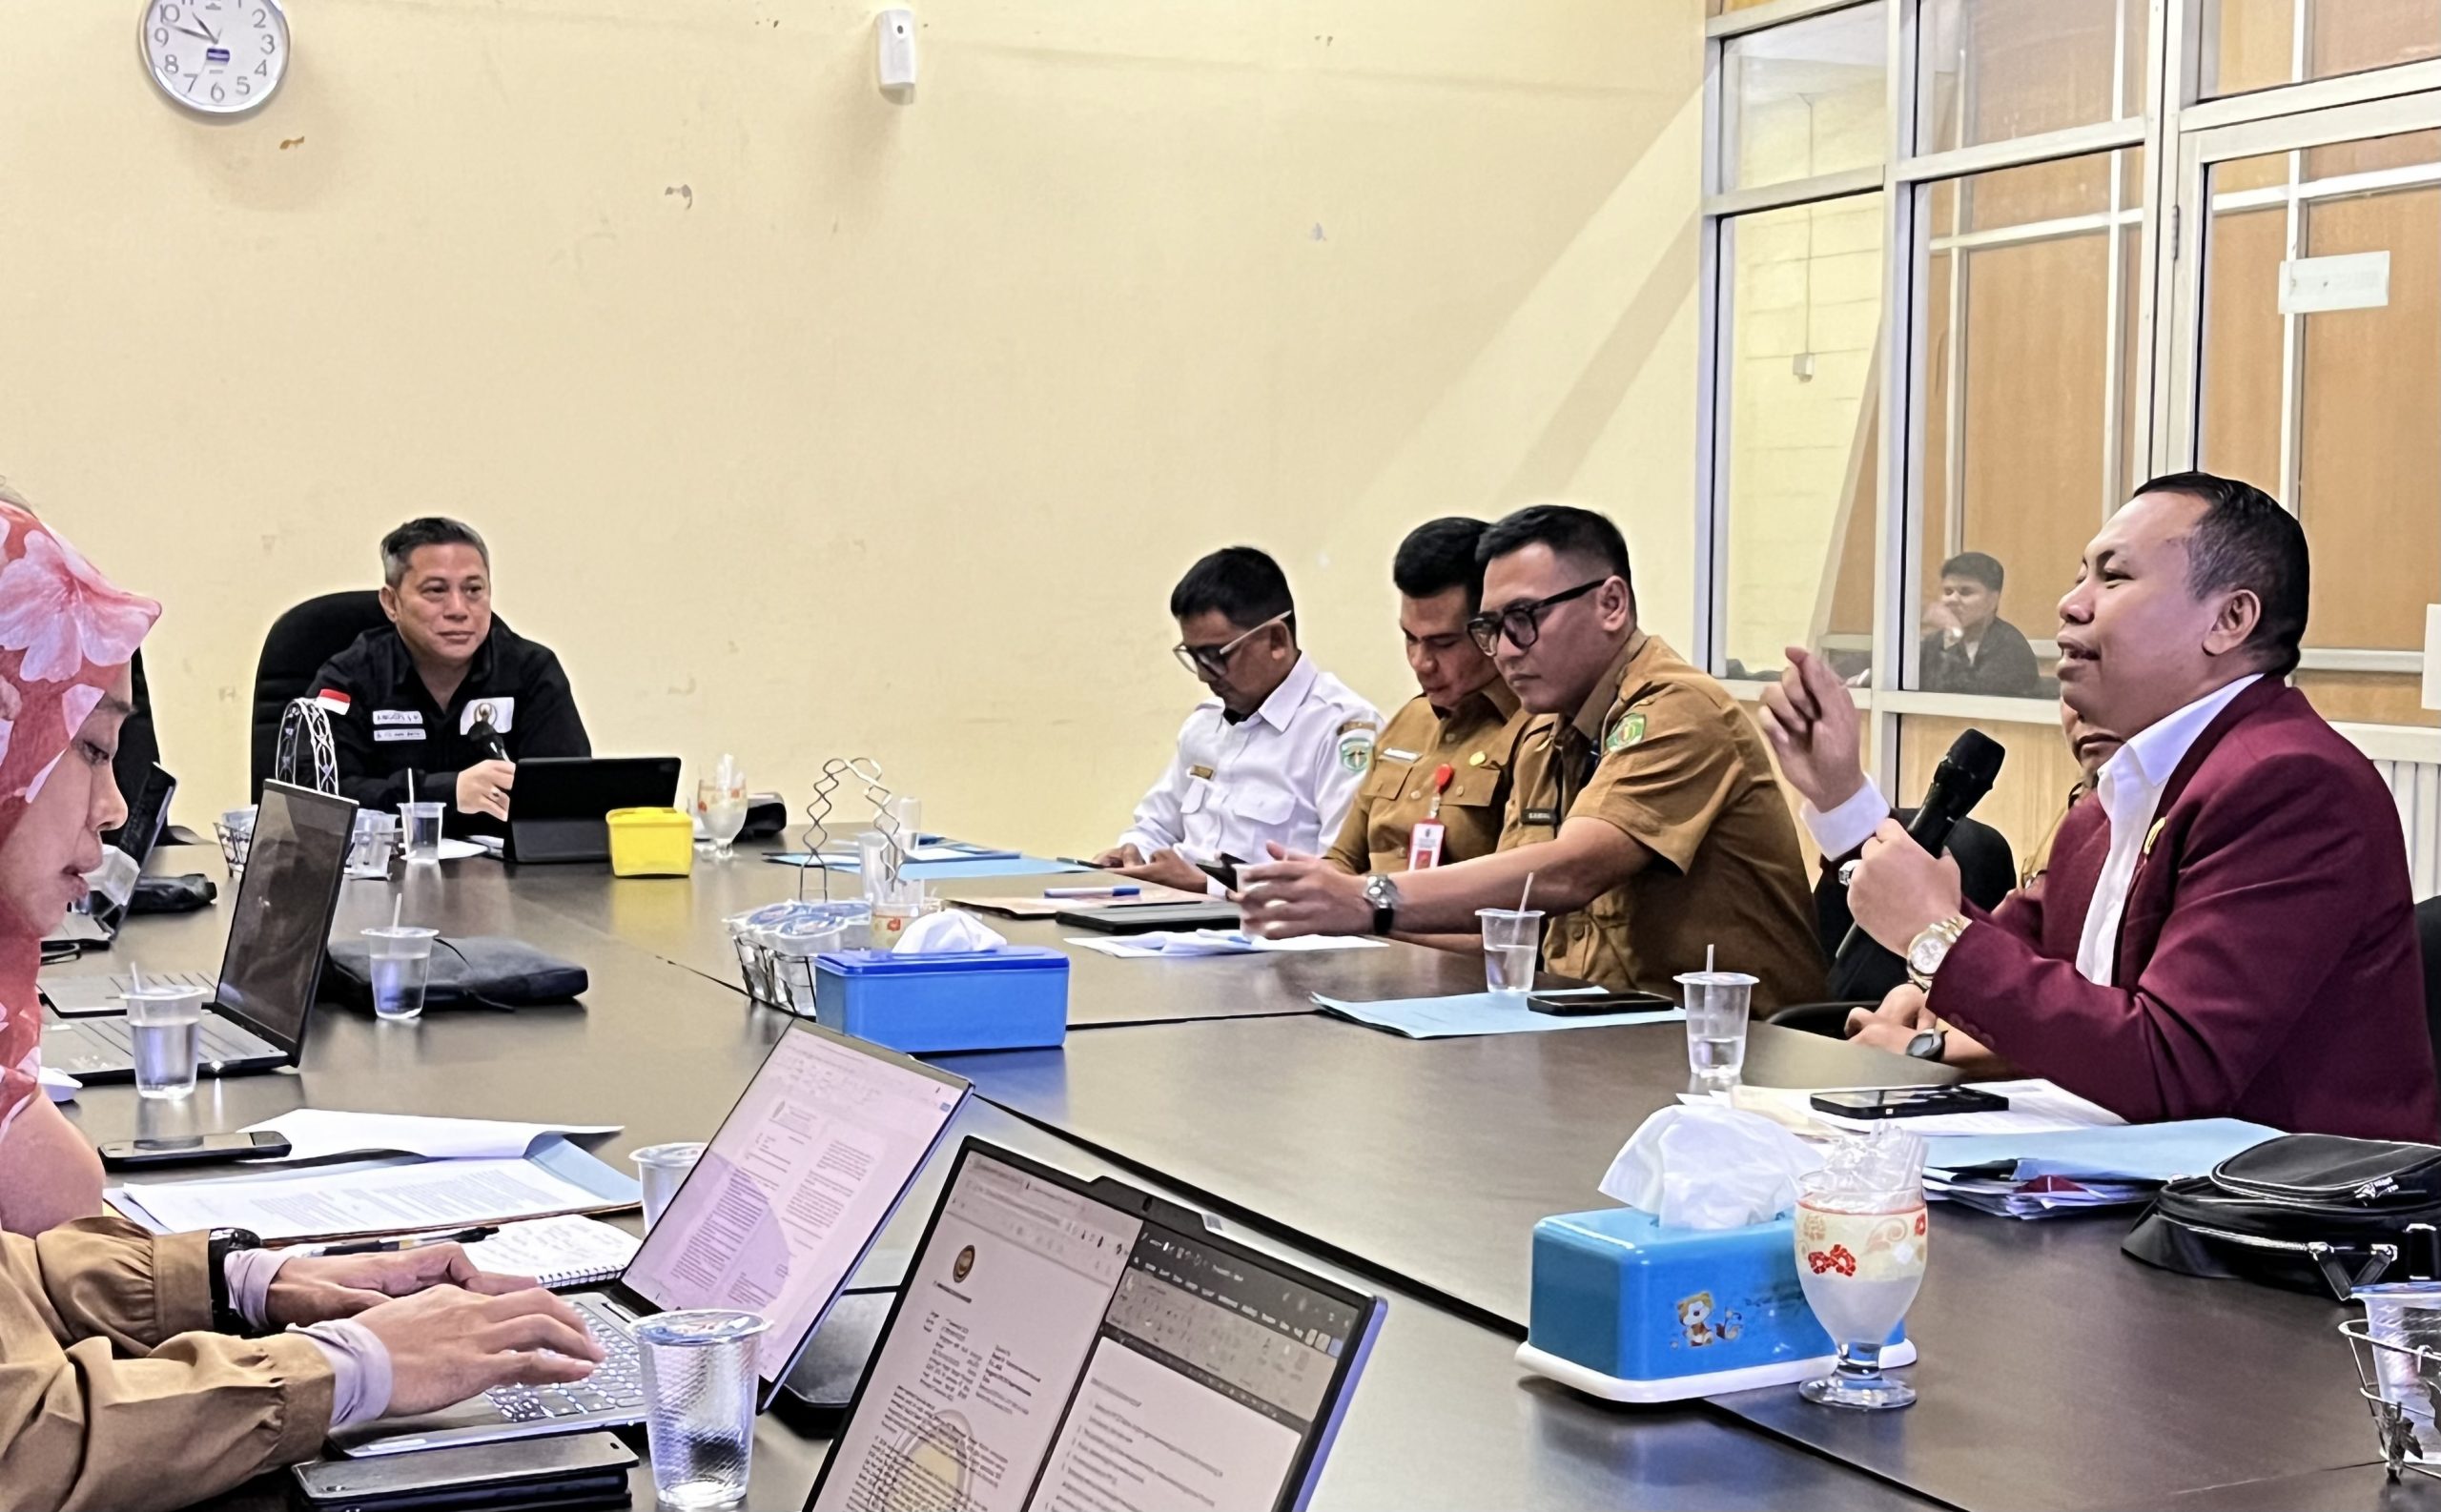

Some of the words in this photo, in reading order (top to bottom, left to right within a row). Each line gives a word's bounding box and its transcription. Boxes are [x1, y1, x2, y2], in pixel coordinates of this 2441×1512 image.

[160, 4, 180, 24] 10
[252, 9, 266, 29] 2
[154, 27, 169, 47] 9
[260, 33, 276, 55] 3
[165, 54, 179, 74] 8
[254, 59, 268, 77] 4
[183, 73, 198, 92] 7
[211, 82, 225, 103] 6
[236, 76, 251, 95] 5
